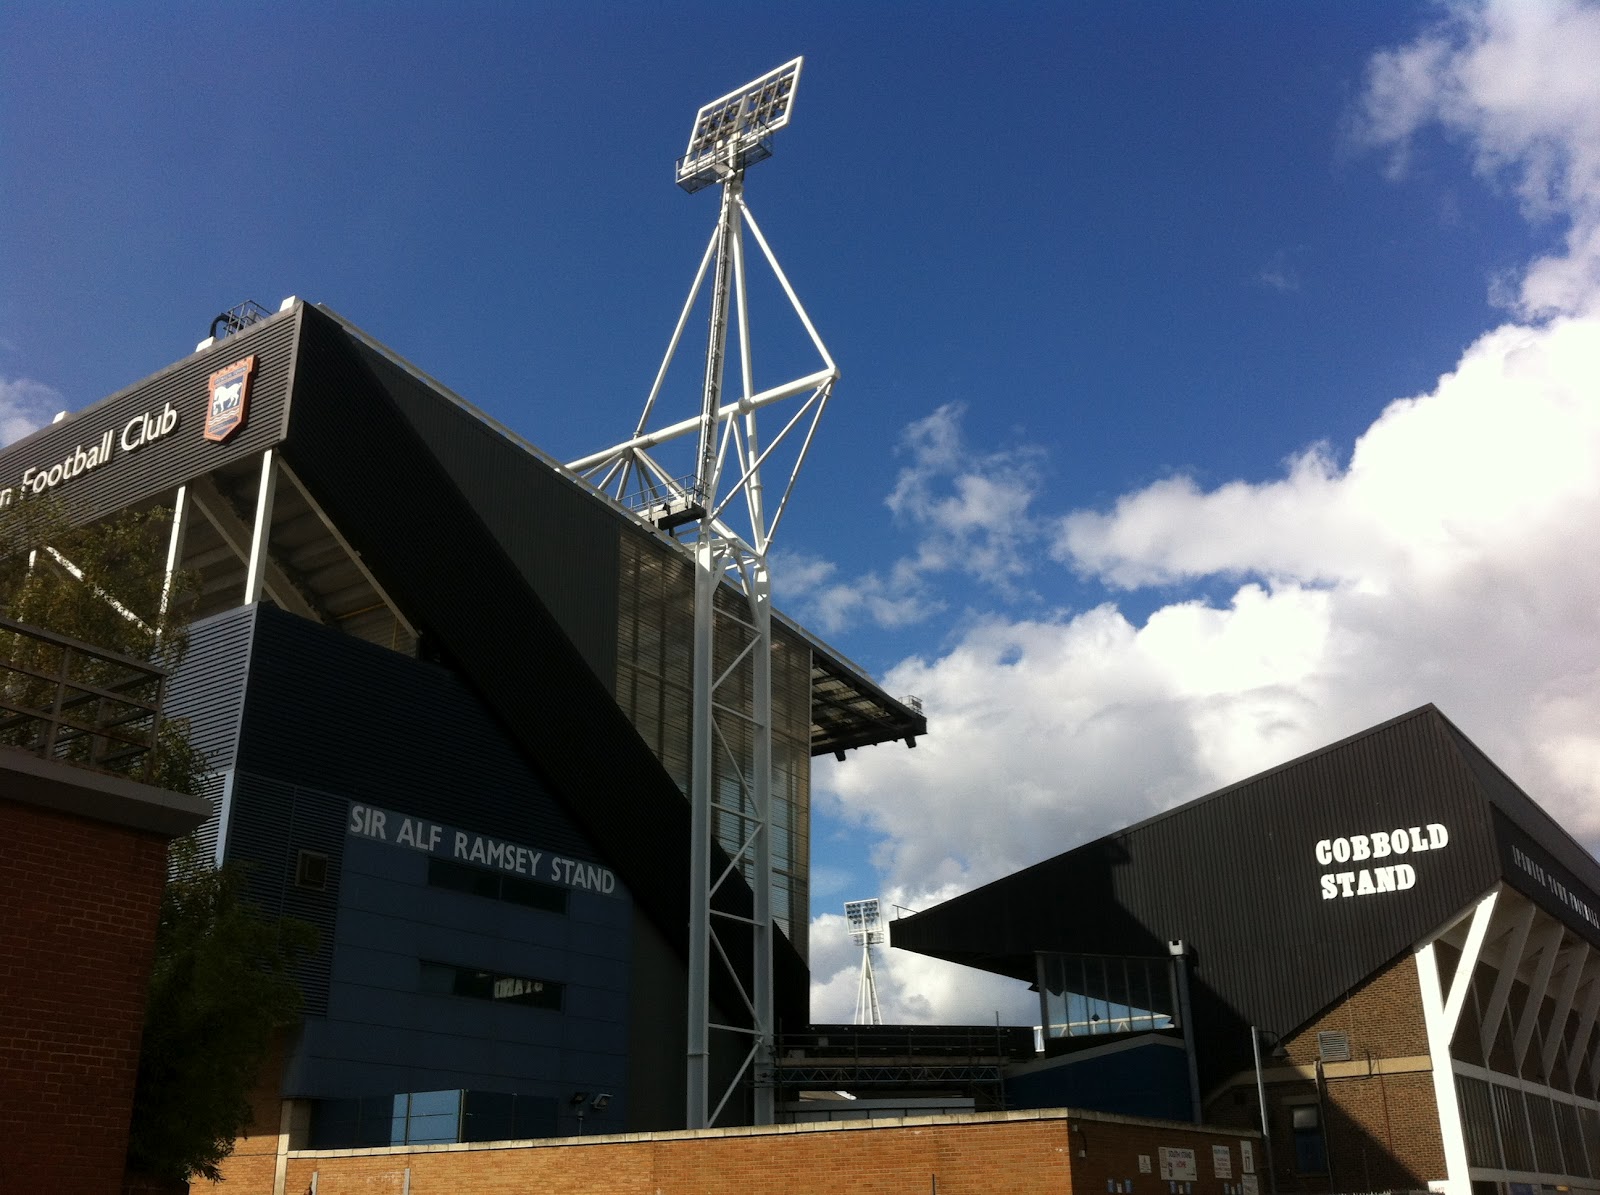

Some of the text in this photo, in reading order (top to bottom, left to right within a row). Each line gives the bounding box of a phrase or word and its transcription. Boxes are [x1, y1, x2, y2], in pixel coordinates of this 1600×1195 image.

[20, 402, 180, 500] Football Club
[350, 805, 616, 895] SIR ALF RAMSEY STAND
[1315, 823, 1449, 866] COBBOLD
[1320, 864, 1416, 900] STAND
